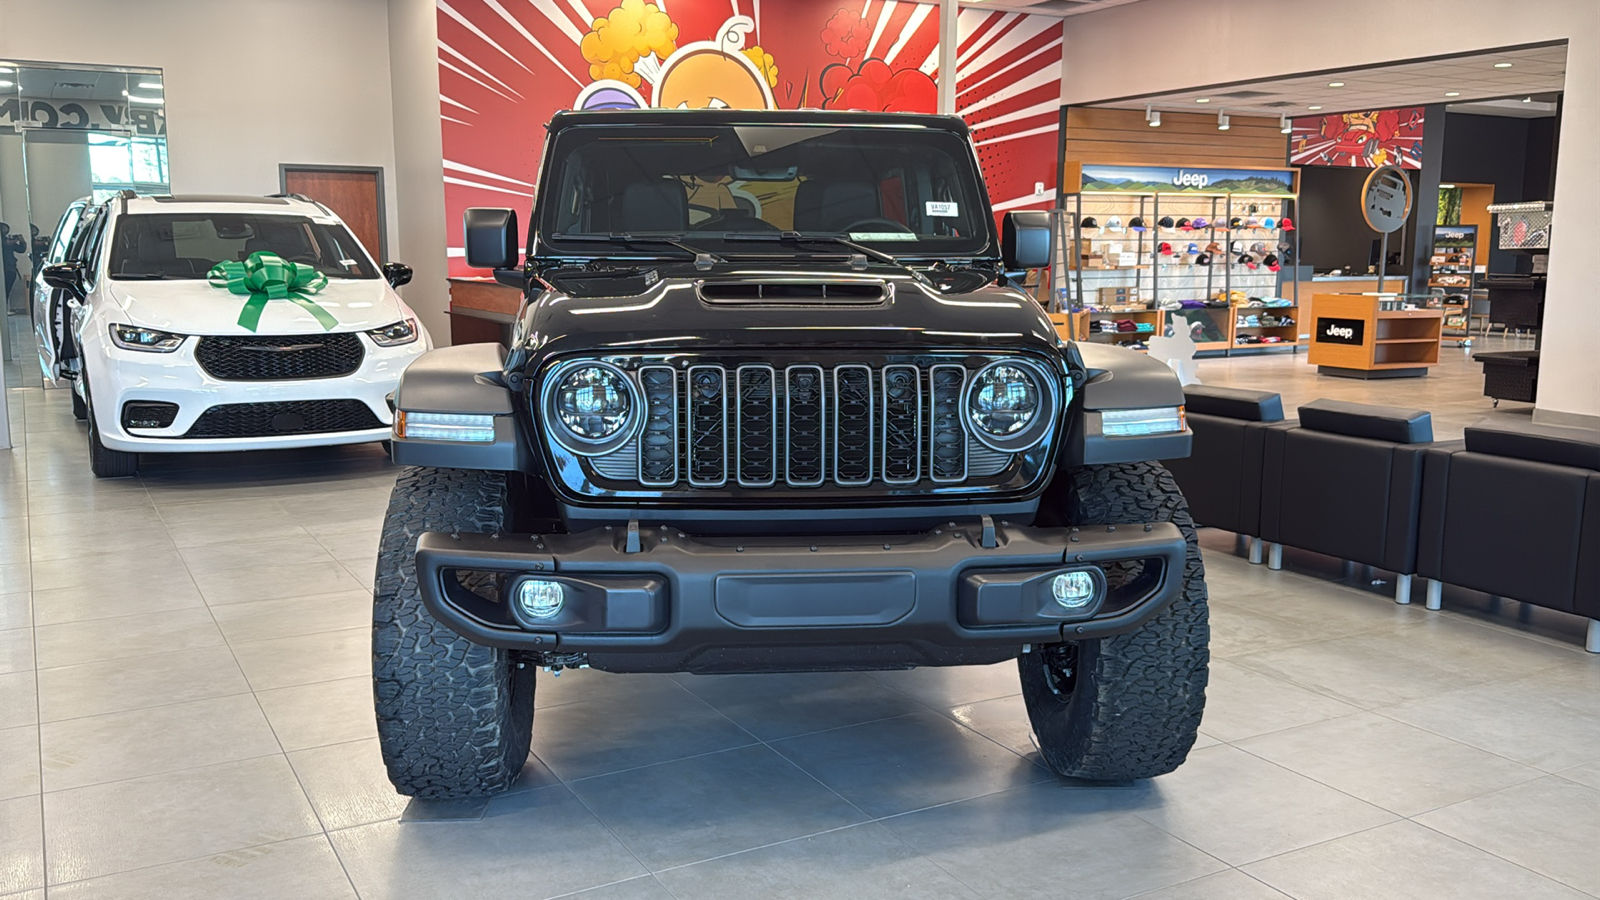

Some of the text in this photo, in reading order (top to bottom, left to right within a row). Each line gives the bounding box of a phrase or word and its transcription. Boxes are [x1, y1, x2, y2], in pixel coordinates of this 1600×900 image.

[1172, 169, 1208, 190] Jeep
[1444, 231, 1465, 239] Jeep
[1326, 323, 1353, 339] Jeep
